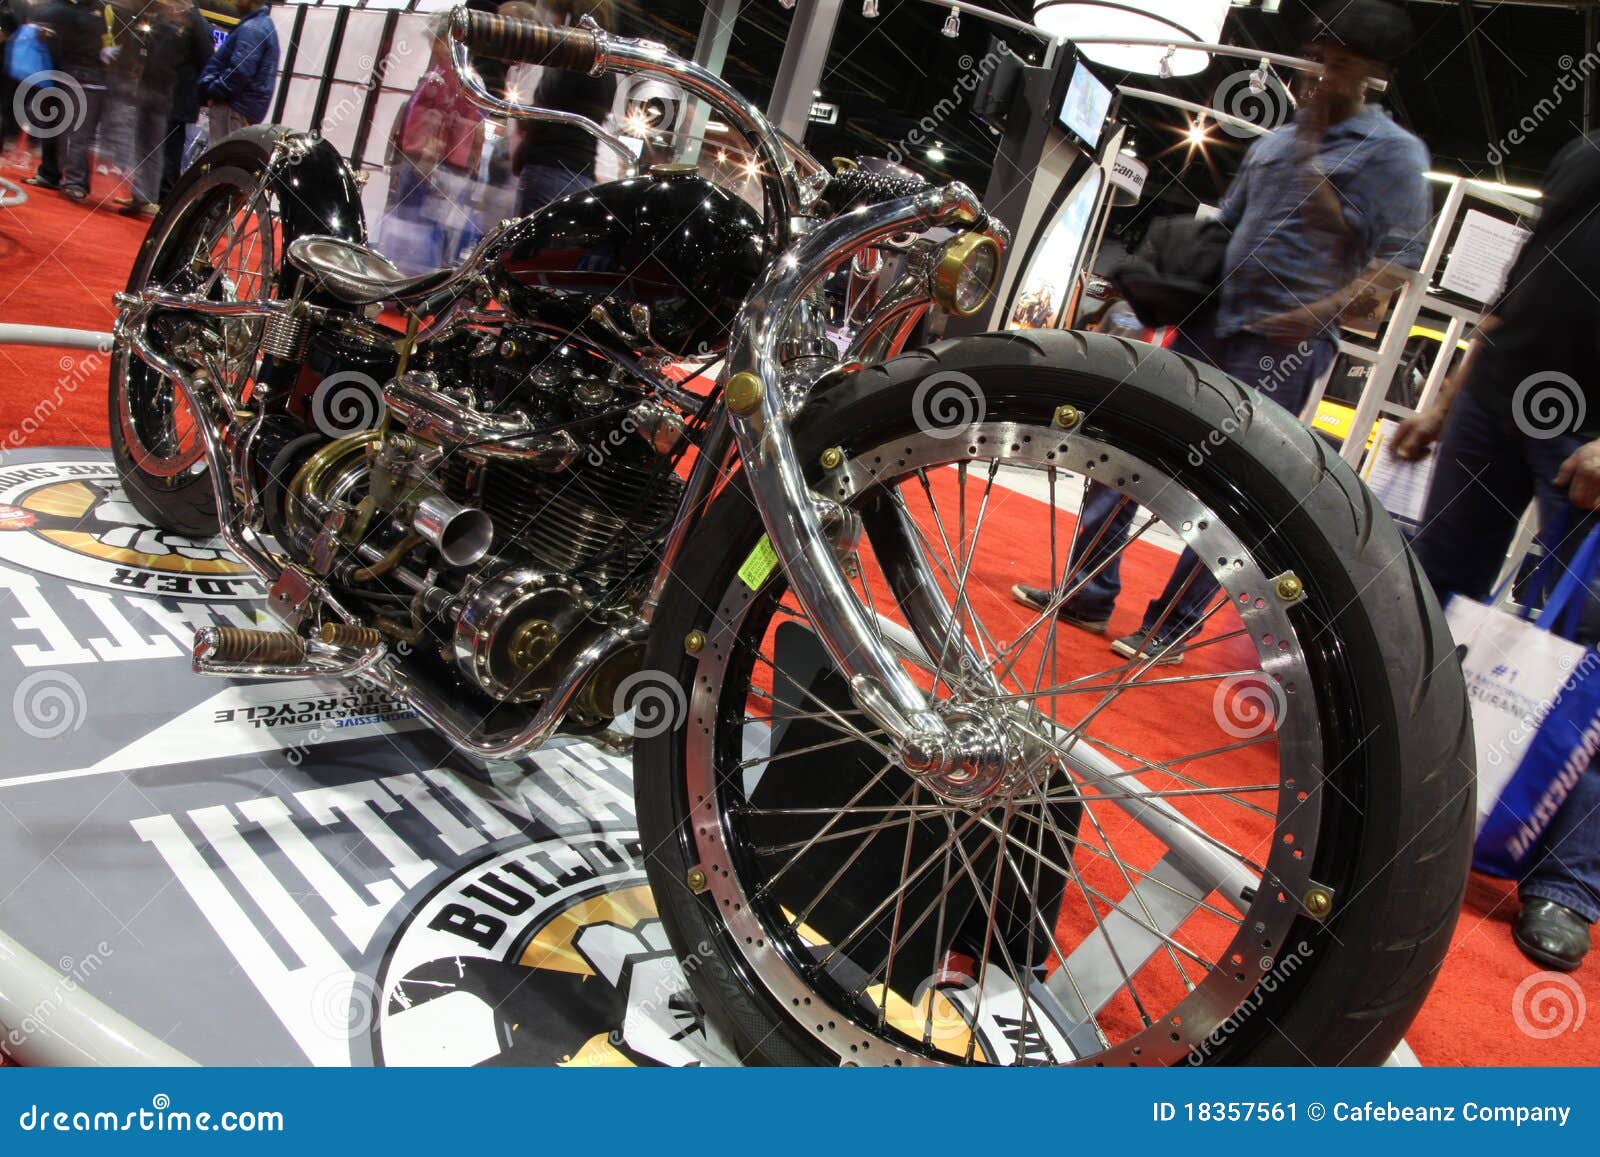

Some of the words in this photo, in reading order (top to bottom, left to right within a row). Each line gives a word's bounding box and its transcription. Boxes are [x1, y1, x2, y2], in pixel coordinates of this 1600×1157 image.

[109, 567, 268, 597] LDER
[1490, 664, 1518, 684] #1
[213, 693, 397, 724] OTORCYCLE
[427, 838, 646, 951] BUILDE
